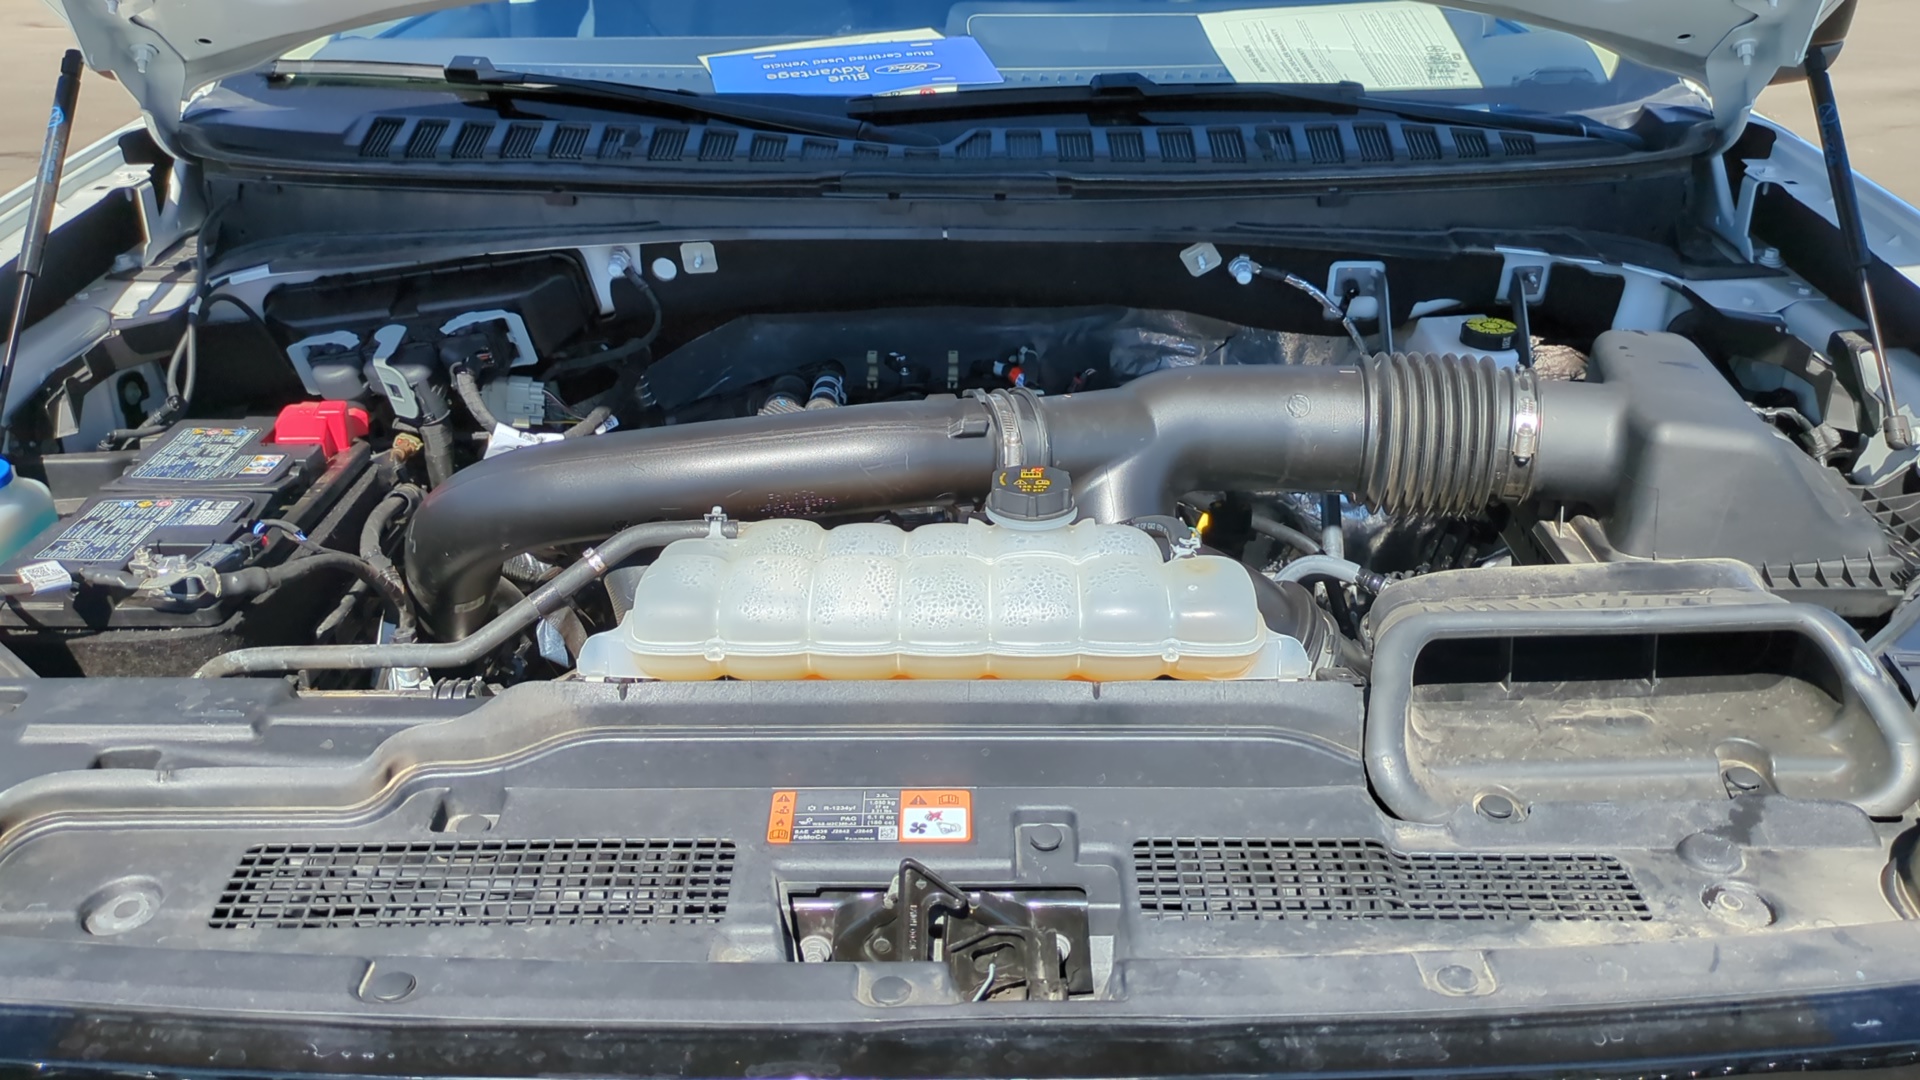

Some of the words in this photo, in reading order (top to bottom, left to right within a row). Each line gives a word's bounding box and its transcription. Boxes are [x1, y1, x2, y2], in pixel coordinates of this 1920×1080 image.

[849, 52, 902, 62] Certified
[906, 50, 934, 58] Blue
[762, 60, 809, 70] Vehicle
[813, 57, 845, 65] Used
[766, 65, 866, 81] Advantage
[828, 72, 870, 83] Blue
